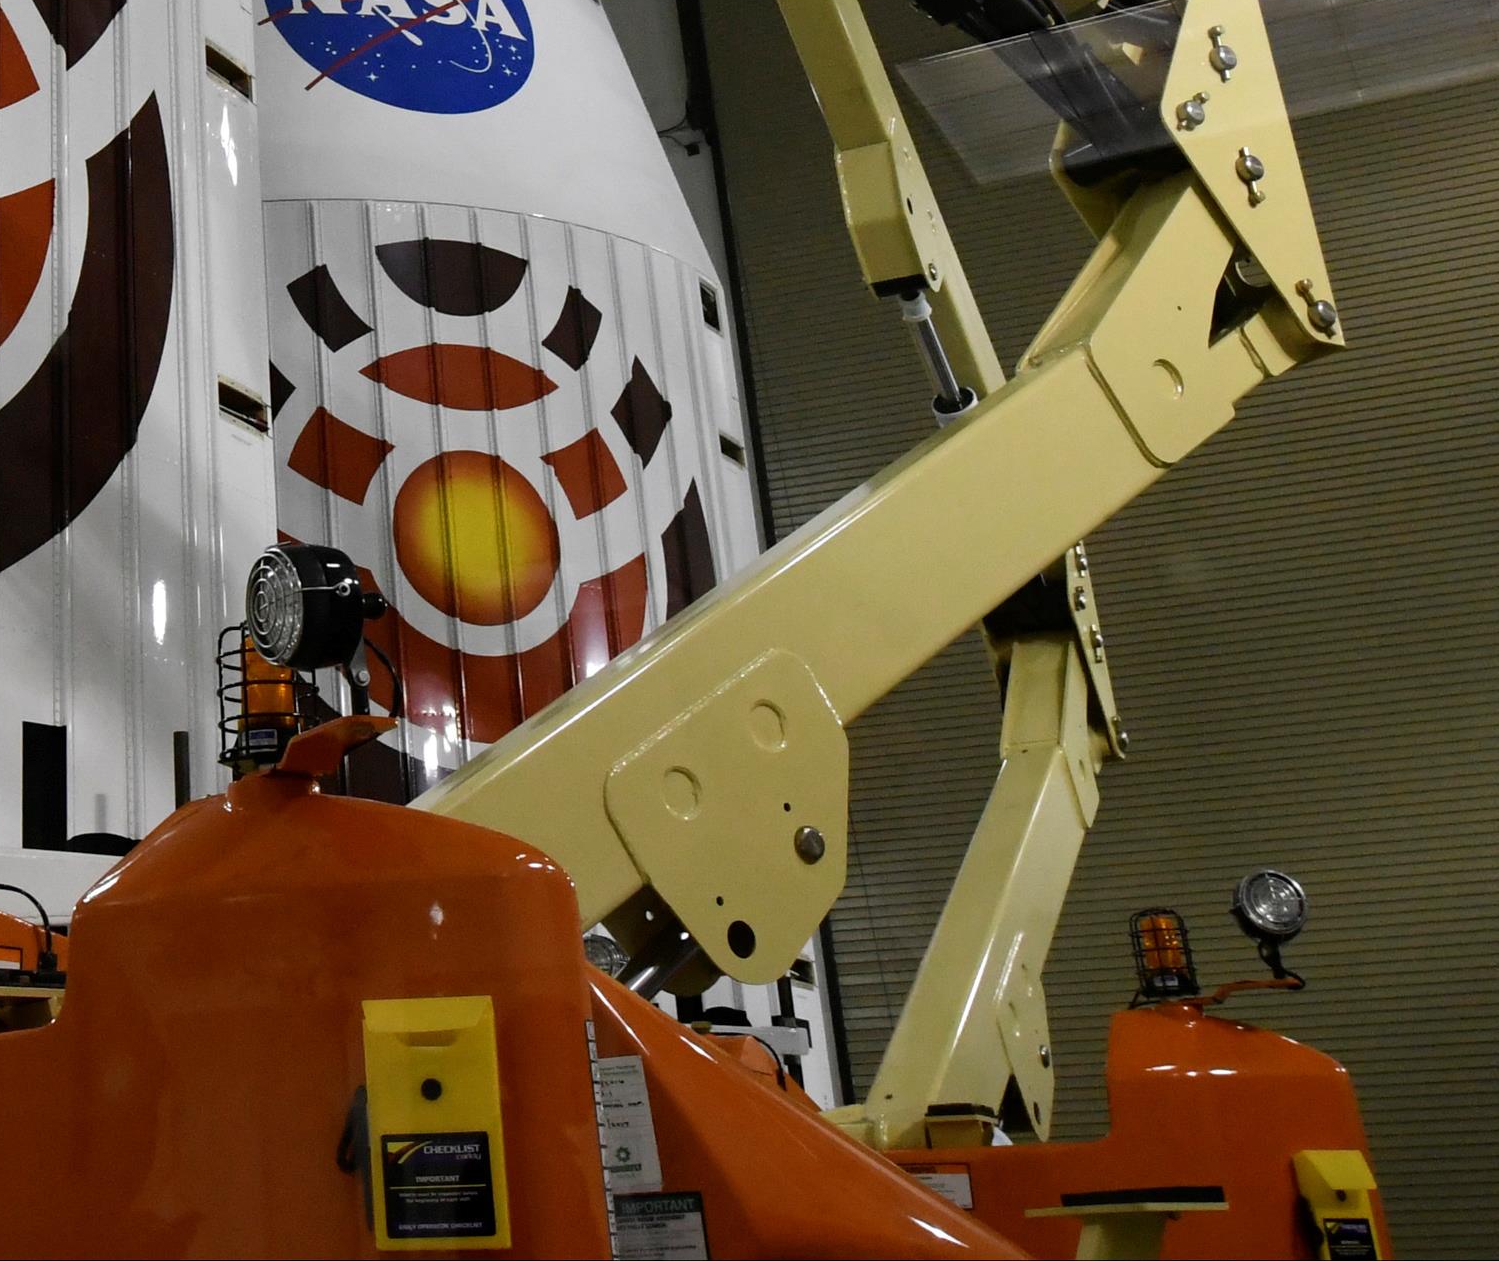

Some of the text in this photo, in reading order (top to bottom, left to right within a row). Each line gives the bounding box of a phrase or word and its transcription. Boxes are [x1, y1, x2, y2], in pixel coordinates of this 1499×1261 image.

[423, 1144, 480, 1154] CHECKLIST
[415, 1175, 460, 1183] IMPORTANT
[621, 1198, 695, 1213] IMPORTANT
